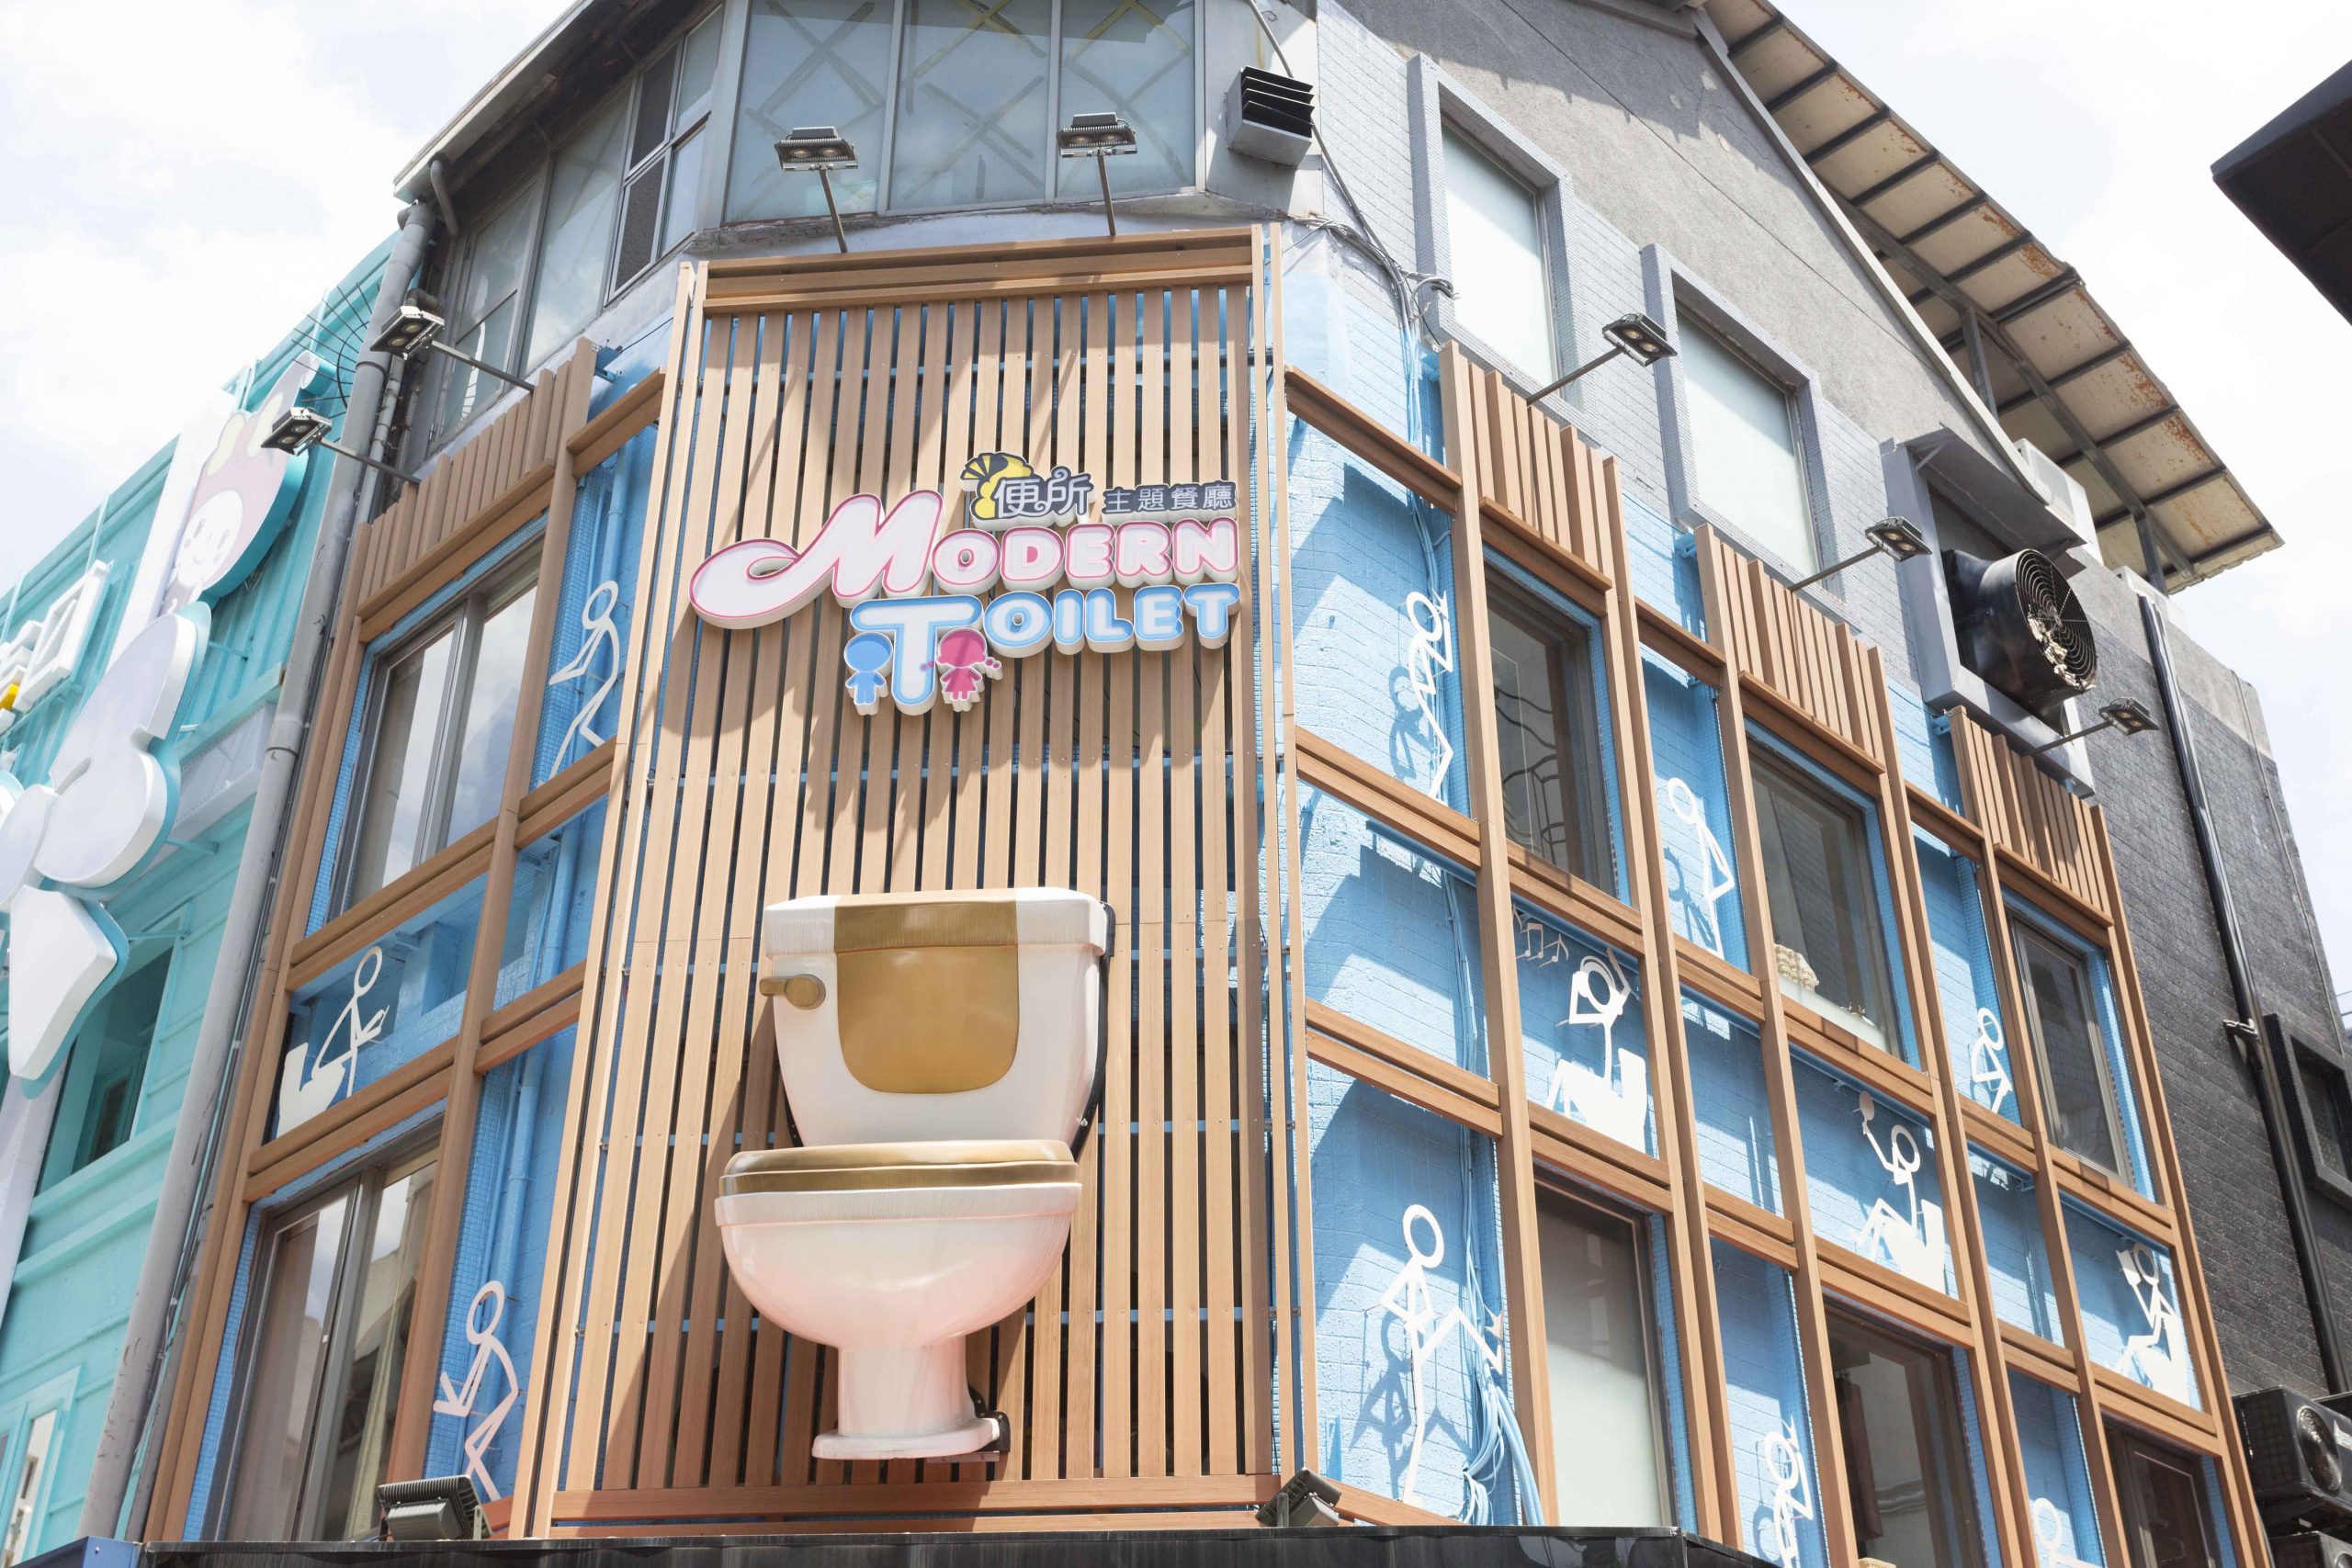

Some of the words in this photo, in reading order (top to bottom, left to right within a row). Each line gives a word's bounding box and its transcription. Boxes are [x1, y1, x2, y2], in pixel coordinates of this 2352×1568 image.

[689, 490, 1239, 620] MODERN
[995, 468, 1091, 518] 便所
[1106, 484, 1234, 513] 主題餐廳
[851, 584, 1240, 708] TOILET
